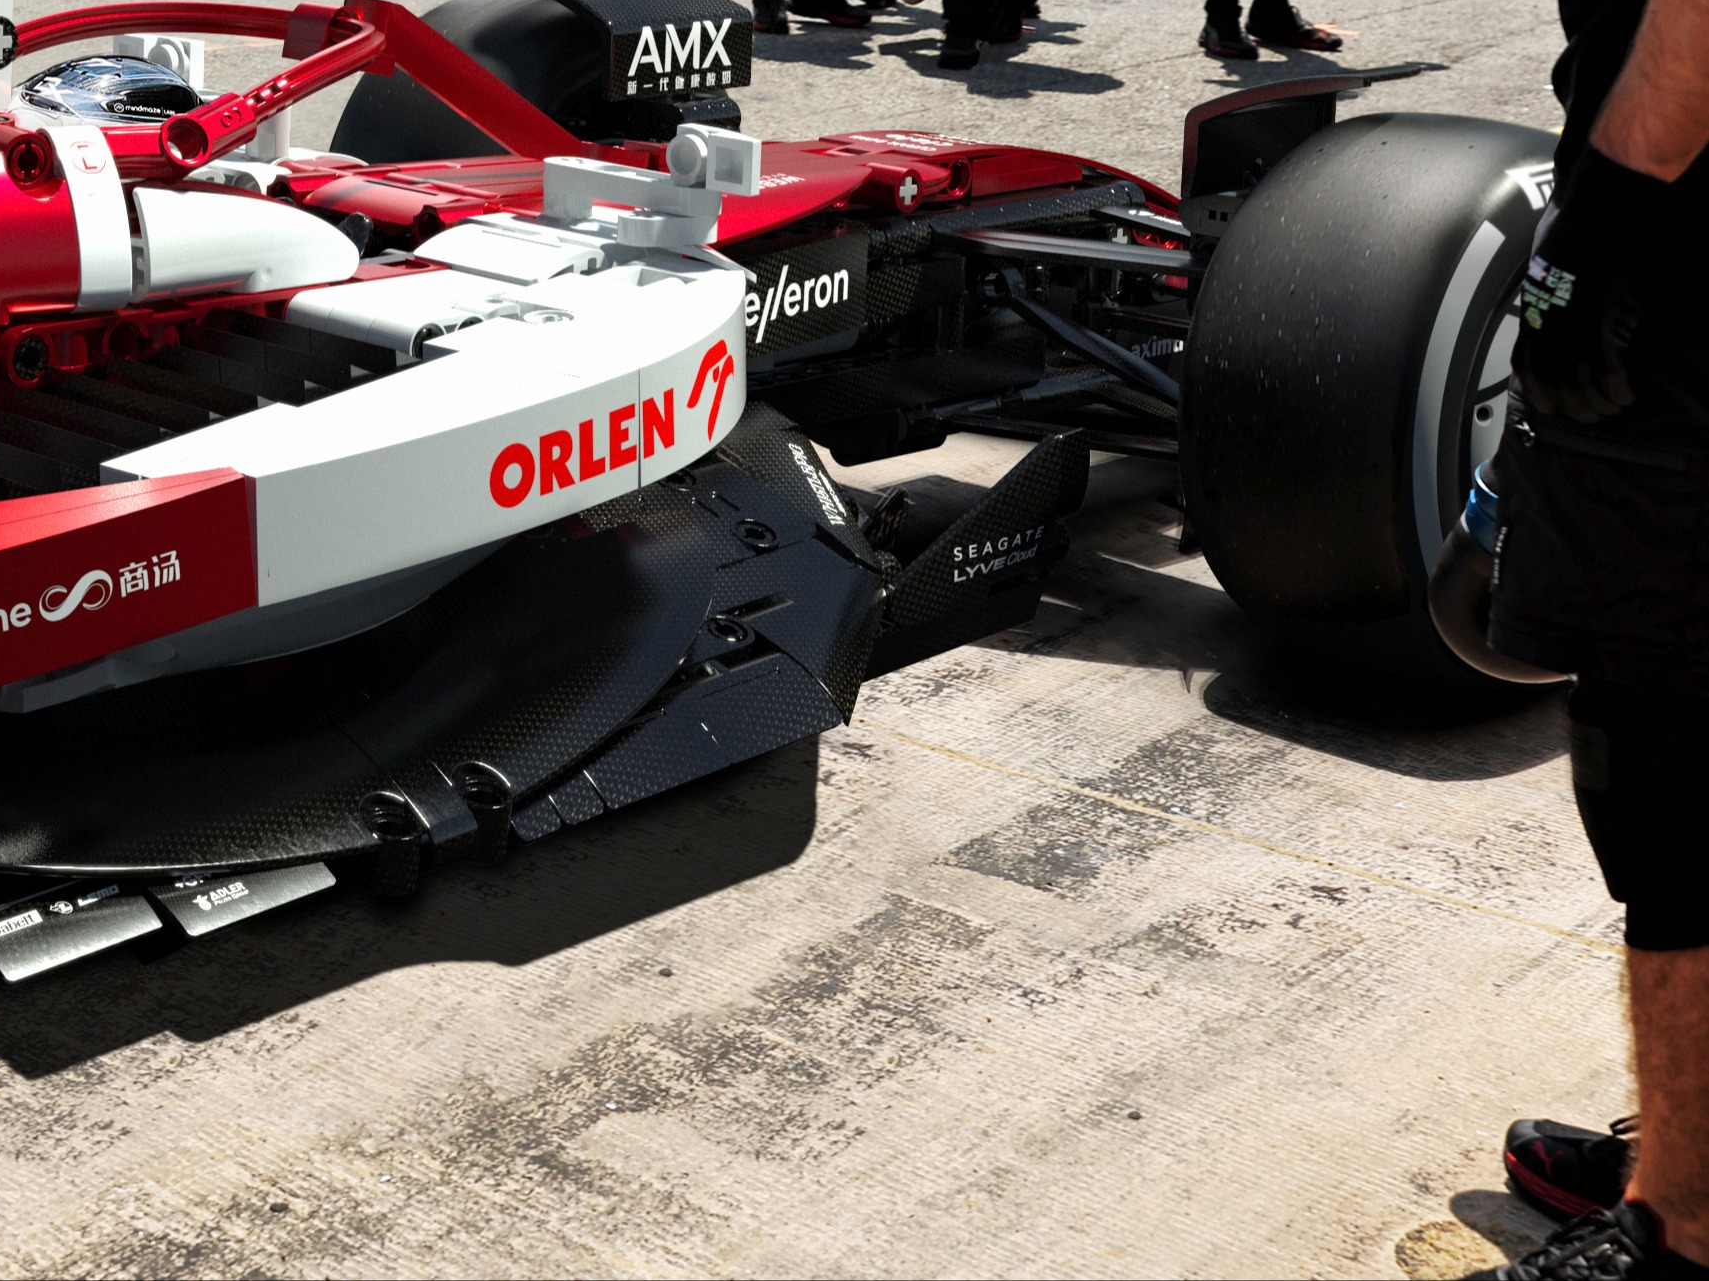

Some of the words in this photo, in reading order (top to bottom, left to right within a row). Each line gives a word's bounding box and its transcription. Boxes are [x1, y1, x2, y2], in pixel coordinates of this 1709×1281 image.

[627, 18, 732, 78] AMX
[125, 104, 161, 114] mindmaze
[489, 387, 676, 509] ORLEN
[954, 526, 1045, 562] SEAGATE
[954, 556, 1007, 583] LYVE
[1006, 544, 1038, 567] Cloud
[118, 550, 182, 599] 商汤
[209, 881, 246, 901] ADLER
